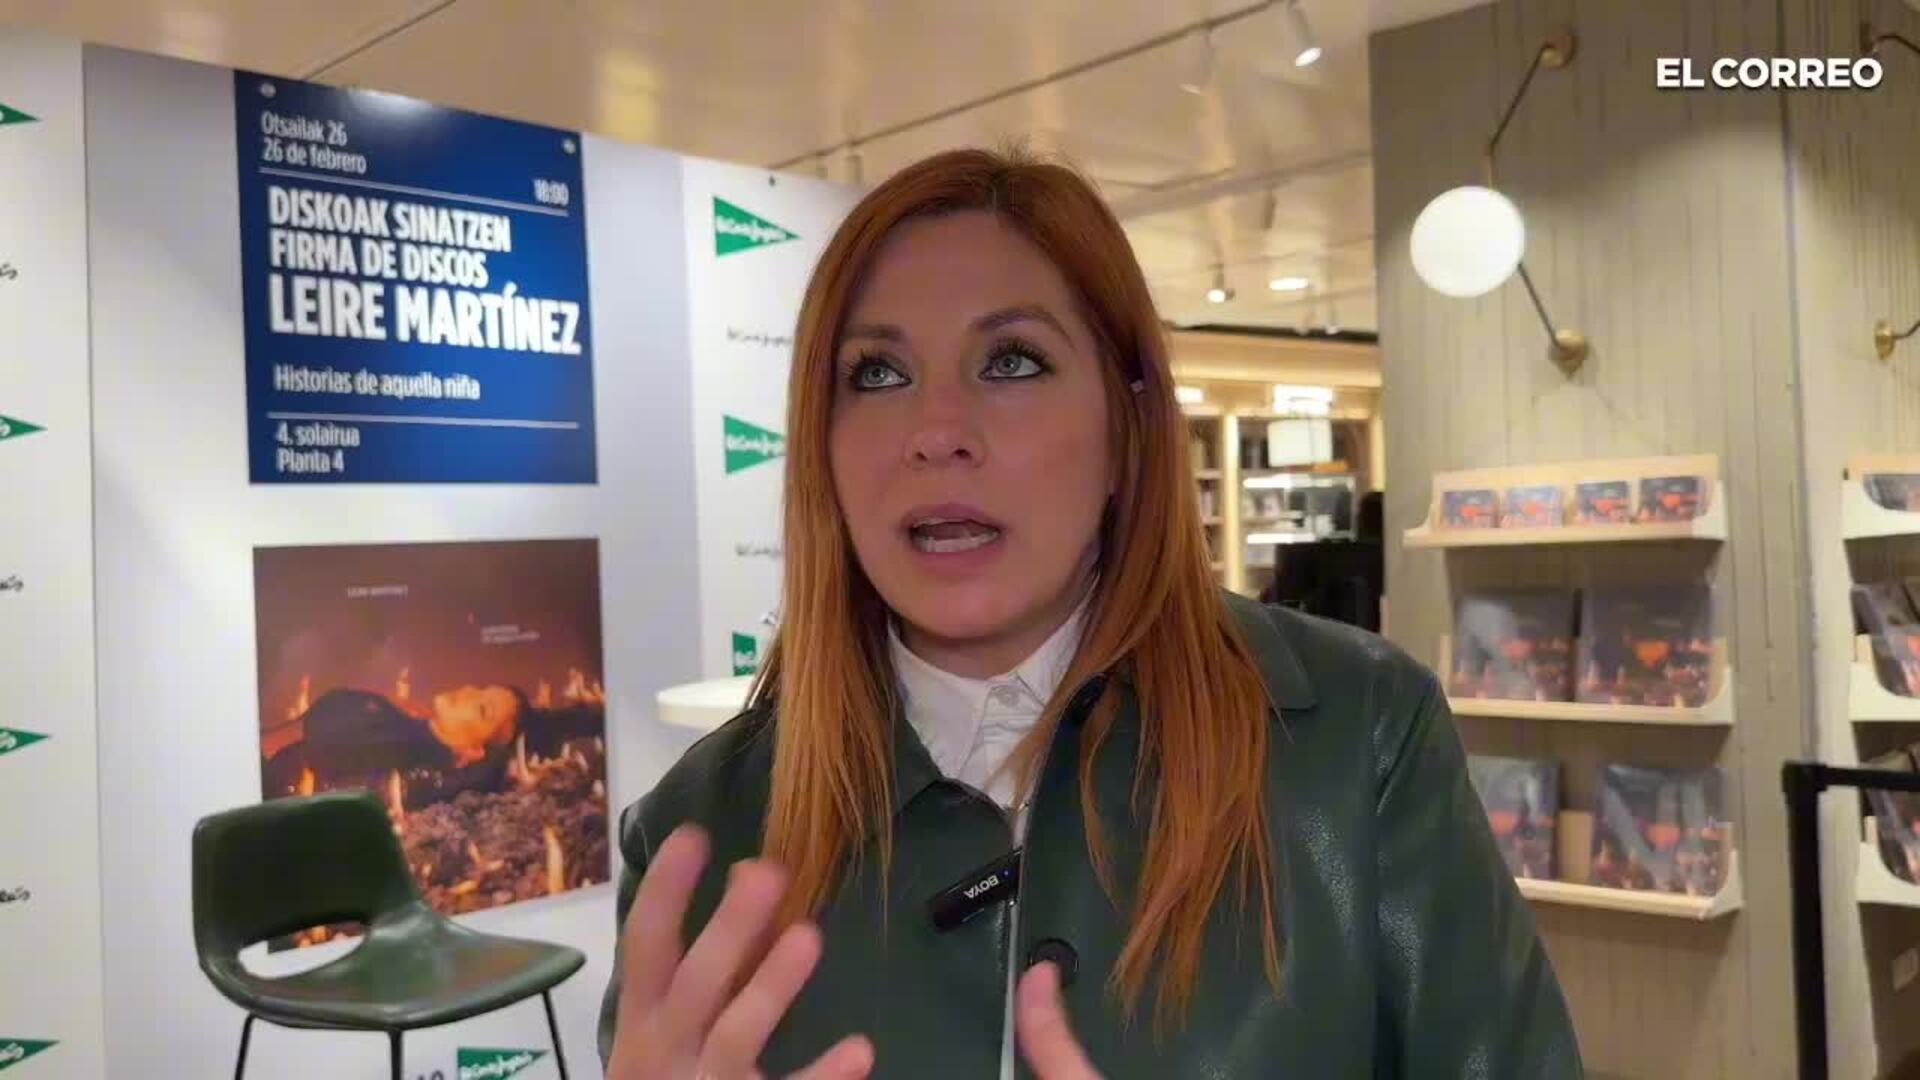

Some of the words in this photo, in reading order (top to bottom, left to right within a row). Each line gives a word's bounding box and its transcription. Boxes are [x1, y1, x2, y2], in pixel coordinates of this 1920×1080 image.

[262, 111, 324, 142] Otsailak
[327, 121, 347, 146] 26
[263, 138, 283, 162] 26
[286, 142, 307, 166] de
[310, 144, 367, 174] febrero
[269, 186, 390, 238] DISKOAK
[393, 203, 511, 252] SINATZEN
[270, 228, 358, 275] FIRMA
[362, 238, 398, 279] DE
[402, 243, 489, 288] DISCOS
[269, 273, 387, 340] LEIRE
[395, 281, 581, 355] MARTÍNEZ
[274, 364, 352, 394] Historias
[354, 368, 378, 395] de
[379, 371, 442, 400] aquella
[443, 373, 480, 399] niña
[276, 422, 293, 445] 4.
[295, 422, 360, 447] solairua
[276, 448, 330, 473] Planta
[333, 449, 345, 472] 4
[963, 875, 1000, 899] BOYA
